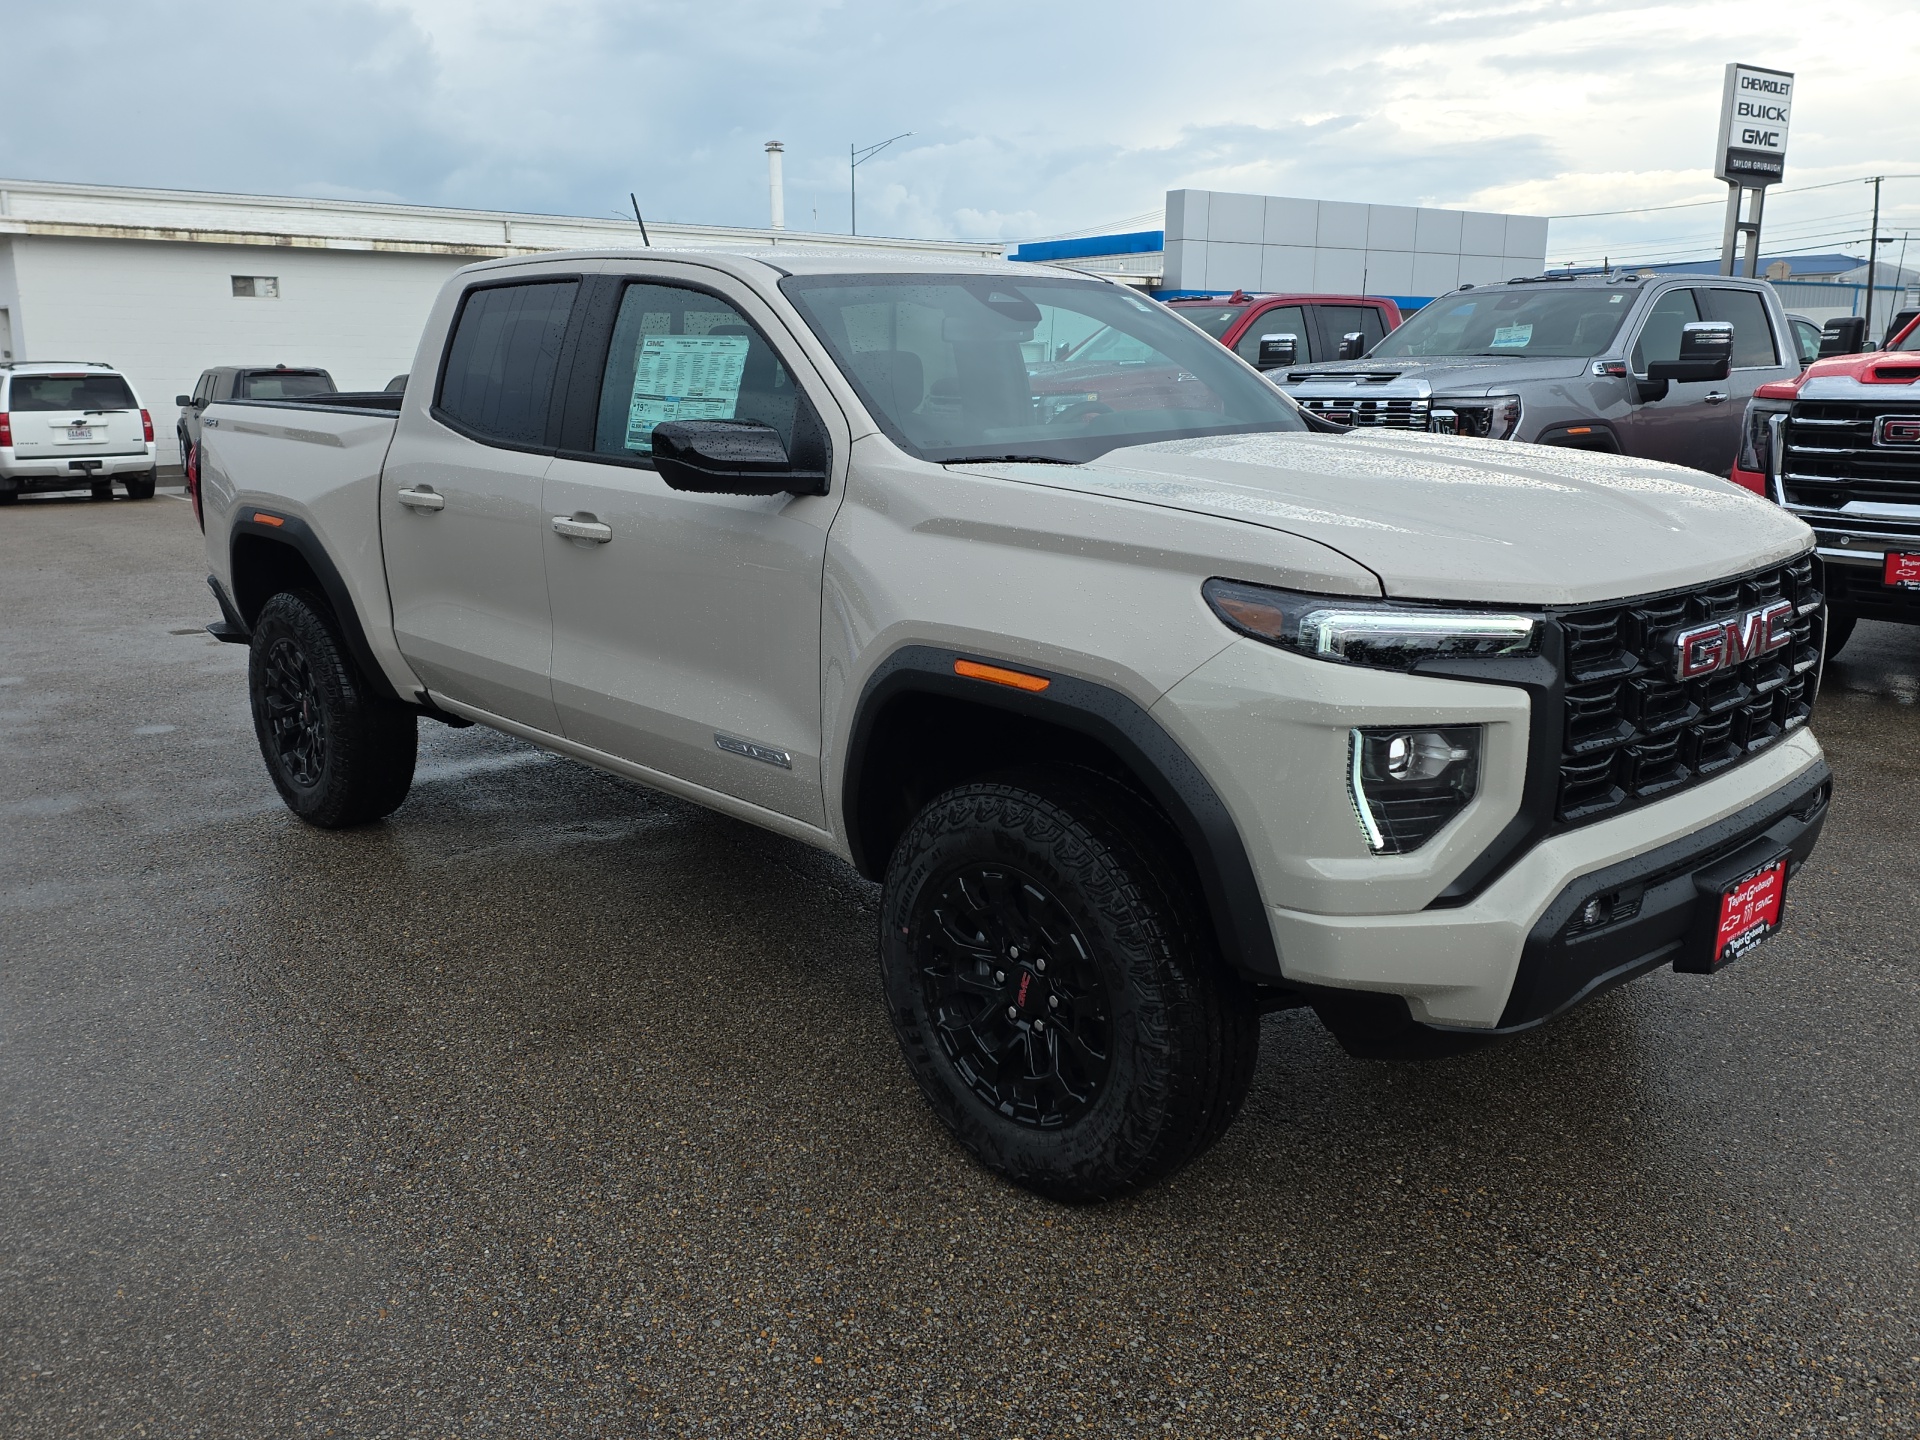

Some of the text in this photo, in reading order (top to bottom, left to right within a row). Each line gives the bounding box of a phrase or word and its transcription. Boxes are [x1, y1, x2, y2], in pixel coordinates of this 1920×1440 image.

[1741, 76, 1790, 96] CHEVROLET
[1737, 101, 1787, 122] BUICK
[1741, 128, 1779, 148] GMC
[1733, 159, 1781, 172] TAYLOR GRUBAUGH
[1677, 598, 1792, 682] GMC
[896, 861, 927, 930] TERRITORY
[1728, 875, 1774, 912] Taylor Grubaugh
[1755, 894, 1774, 912] GMC
[1017, 971, 1031, 1008] GMC
